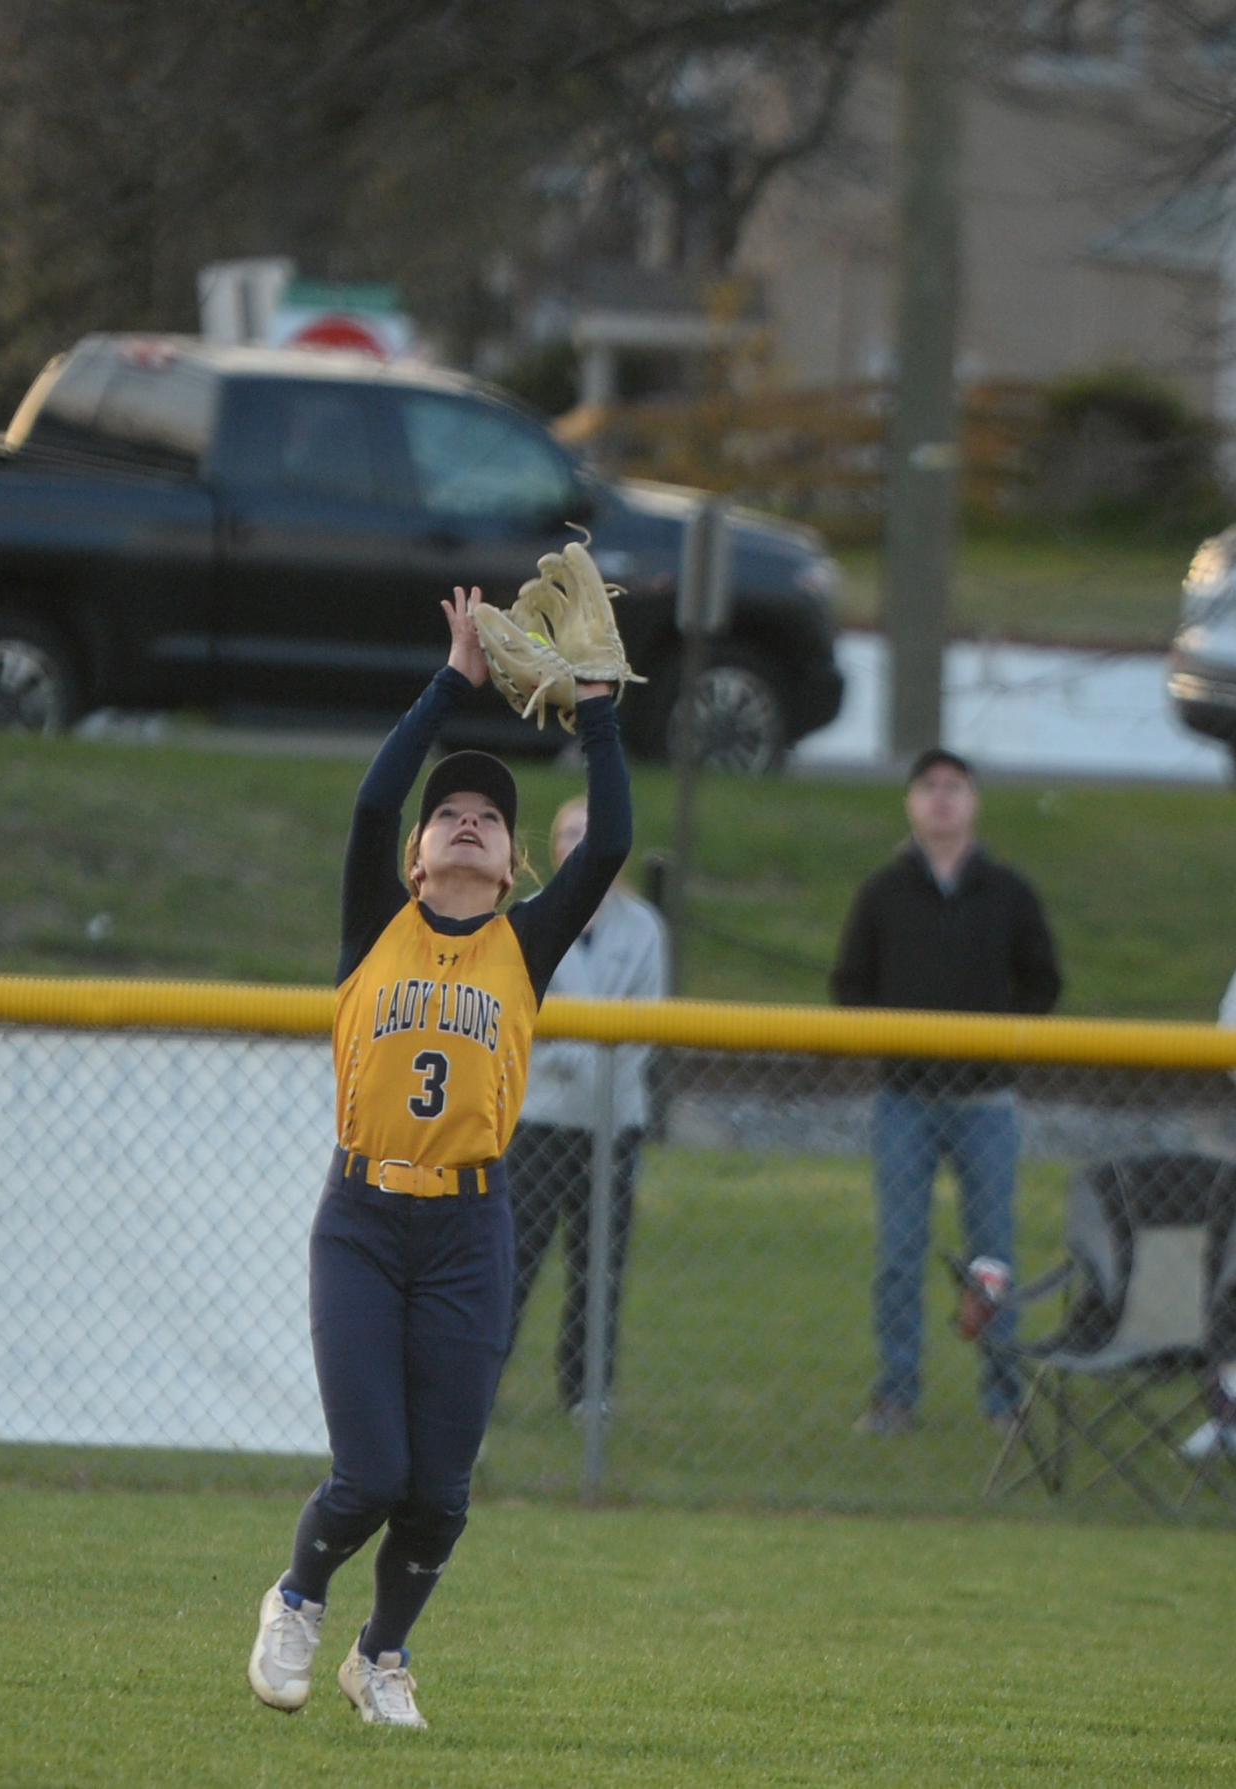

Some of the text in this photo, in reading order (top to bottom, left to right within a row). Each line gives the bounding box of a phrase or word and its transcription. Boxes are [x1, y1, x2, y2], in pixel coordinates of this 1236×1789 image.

[372, 978, 501, 1053] LADY LIONS
[408, 1049, 449, 1120] 3
